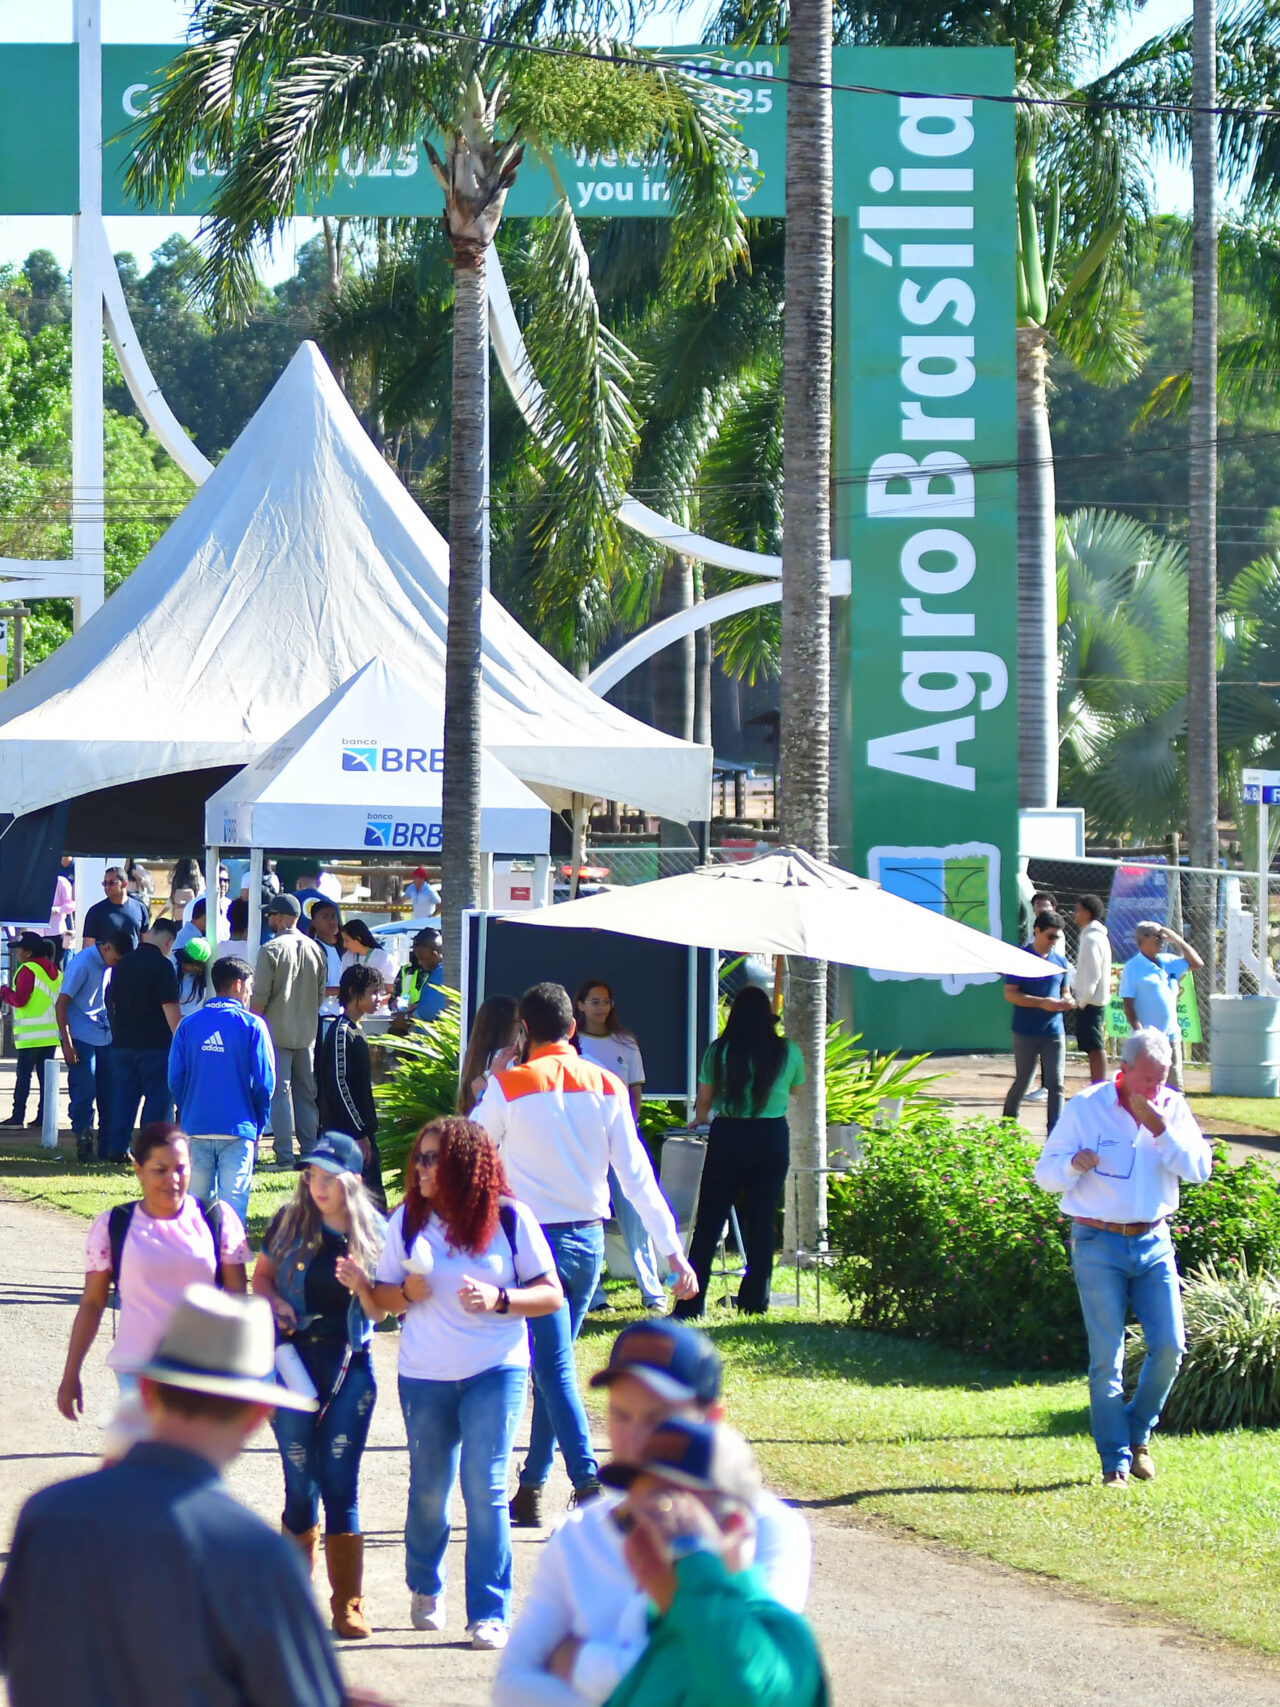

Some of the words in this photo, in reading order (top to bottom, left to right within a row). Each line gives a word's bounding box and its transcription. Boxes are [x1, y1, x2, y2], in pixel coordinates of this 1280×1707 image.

[576, 181, 633, 208] you
[642, 174, 670, 201] in
[859, 94, 1009, 792] AgroBrasília
[392, 822, 442, 848] BRB
[201, 1043, 225, 1053] adidas
